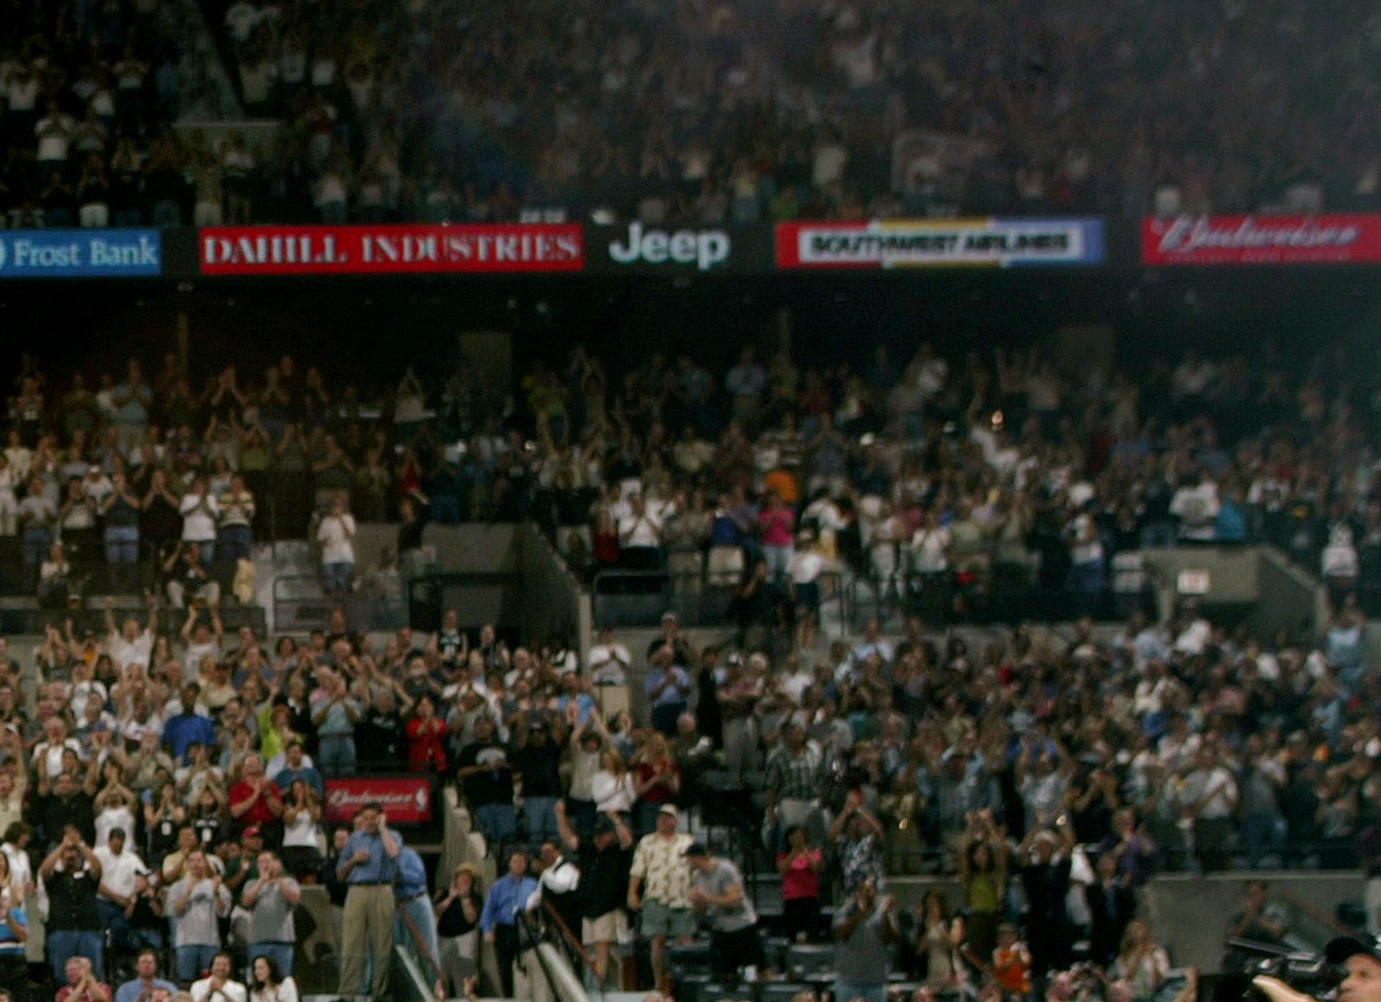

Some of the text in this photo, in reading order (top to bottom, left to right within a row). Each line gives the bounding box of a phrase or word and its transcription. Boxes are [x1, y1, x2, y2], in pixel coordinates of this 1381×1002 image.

[204, 233, 577, 264] DAHILL INDUSTRIES
[608, 221, 731, 271] Jeep
[811, 231, 1070, 255] SOUTHWEST AIRLINES
[1151, 214, 1361, 253] Budweiser
[13, 235, 157, 267] Frost Bank
[328, 788, 414, 806] Budweiser
